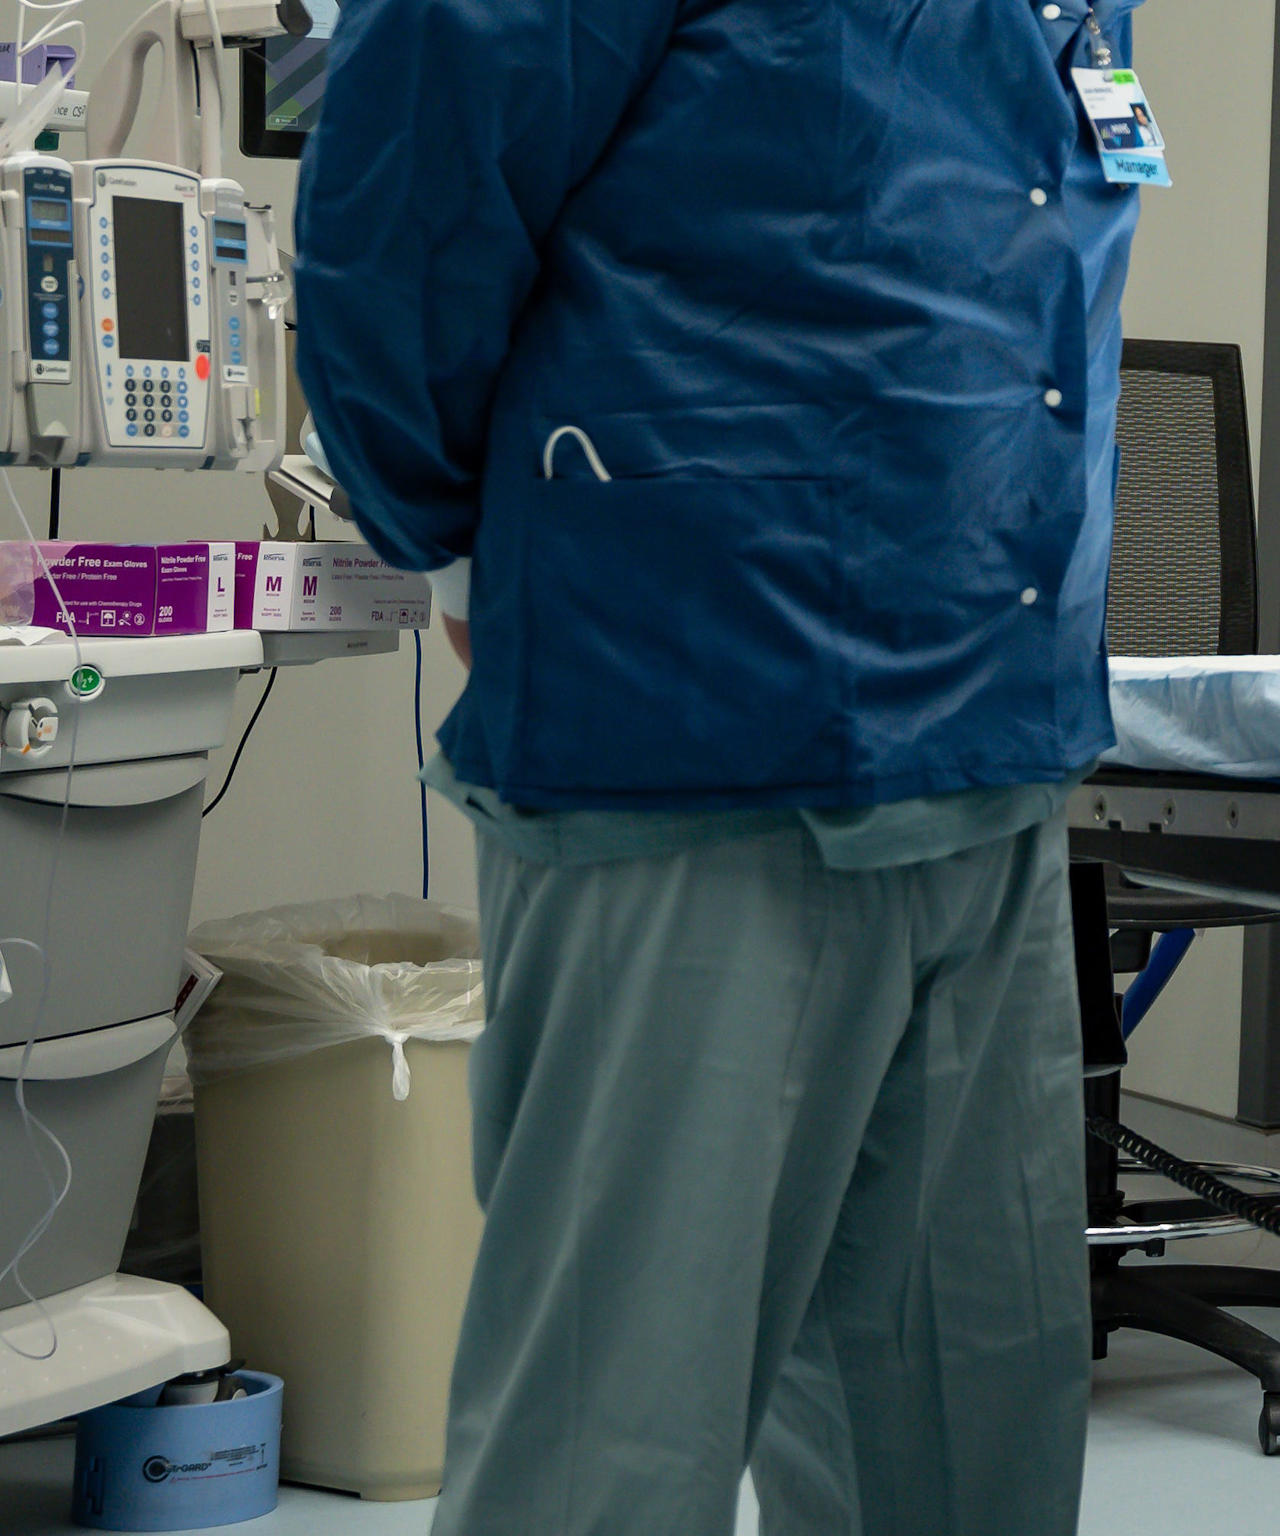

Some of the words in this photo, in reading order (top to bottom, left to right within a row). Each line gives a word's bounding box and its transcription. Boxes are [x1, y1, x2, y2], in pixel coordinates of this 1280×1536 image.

[195, 555, 206, 563] Free
[237, 552, 253, 561] Free
[77, 556, 101, 567] Free
[103, 560, 123, 568] Exam
[123, 560, 148, 569] Gloves
[354, 558, 379, 568] Powder
[217, 577, 225, 592] L
[266, 576, 282, 592] M
[303, 576, 318, 596] M
[159, 606, 172, 616] 200
[330, 606, 342, 616] 200
[371, 611, 383, 621] FDA
[56, 612, 76, 623] FDA
